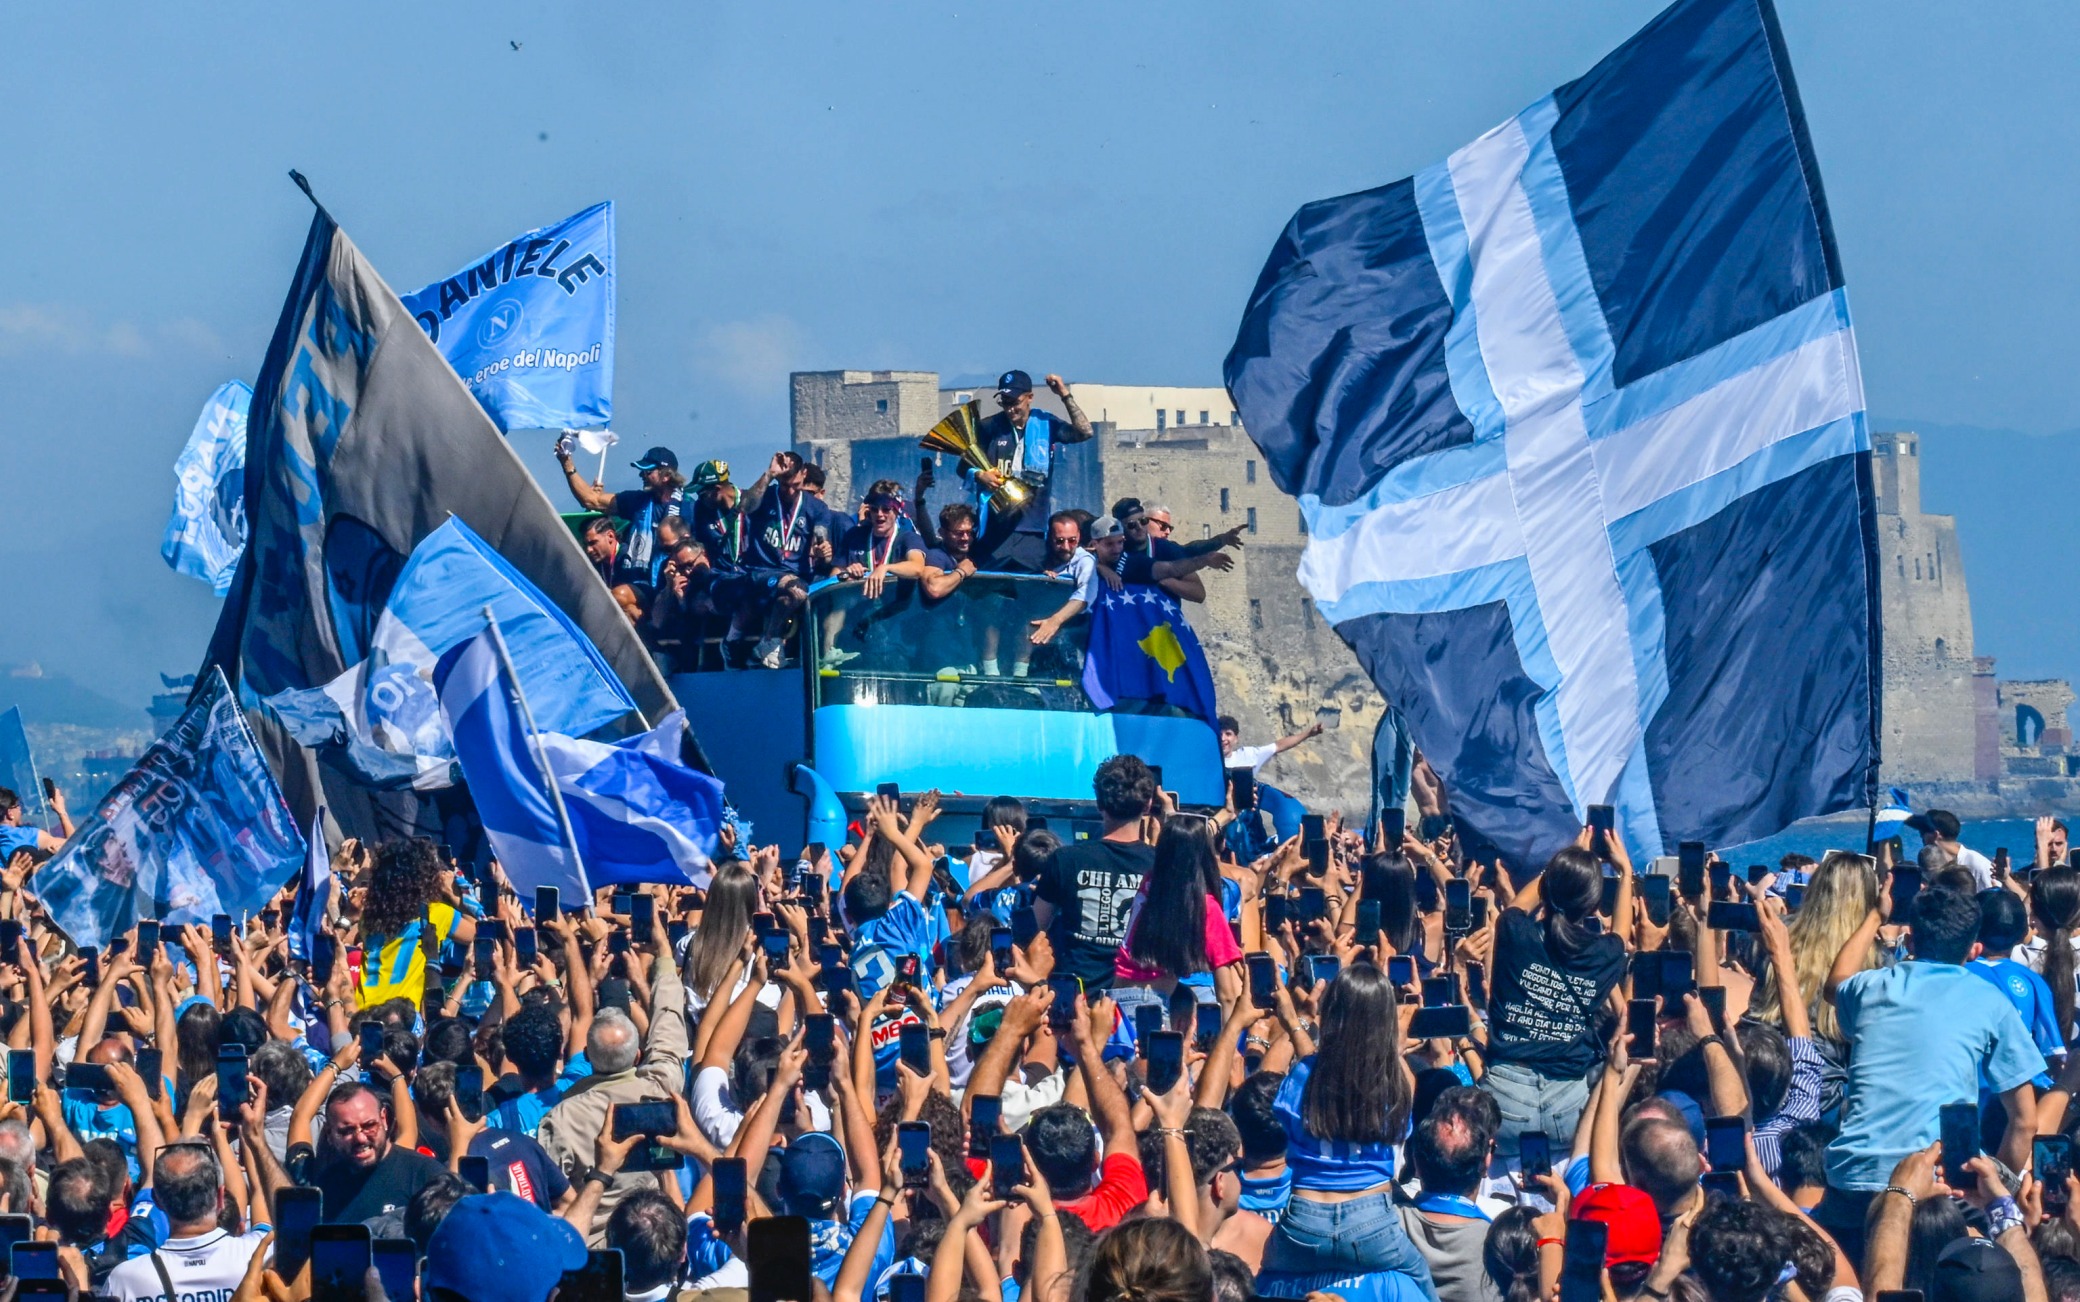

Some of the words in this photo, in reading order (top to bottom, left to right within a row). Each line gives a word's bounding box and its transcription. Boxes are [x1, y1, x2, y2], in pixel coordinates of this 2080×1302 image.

[475, 357, 510, 383] eroe
[513, 349, 541, 368] del
[543, 343, 601, 371] Napoli
[1077, 869, 1111, 888] CHI
[1115, 873, 1143, 889] AM
[1100, 888, 1112, 923] DIEGO
